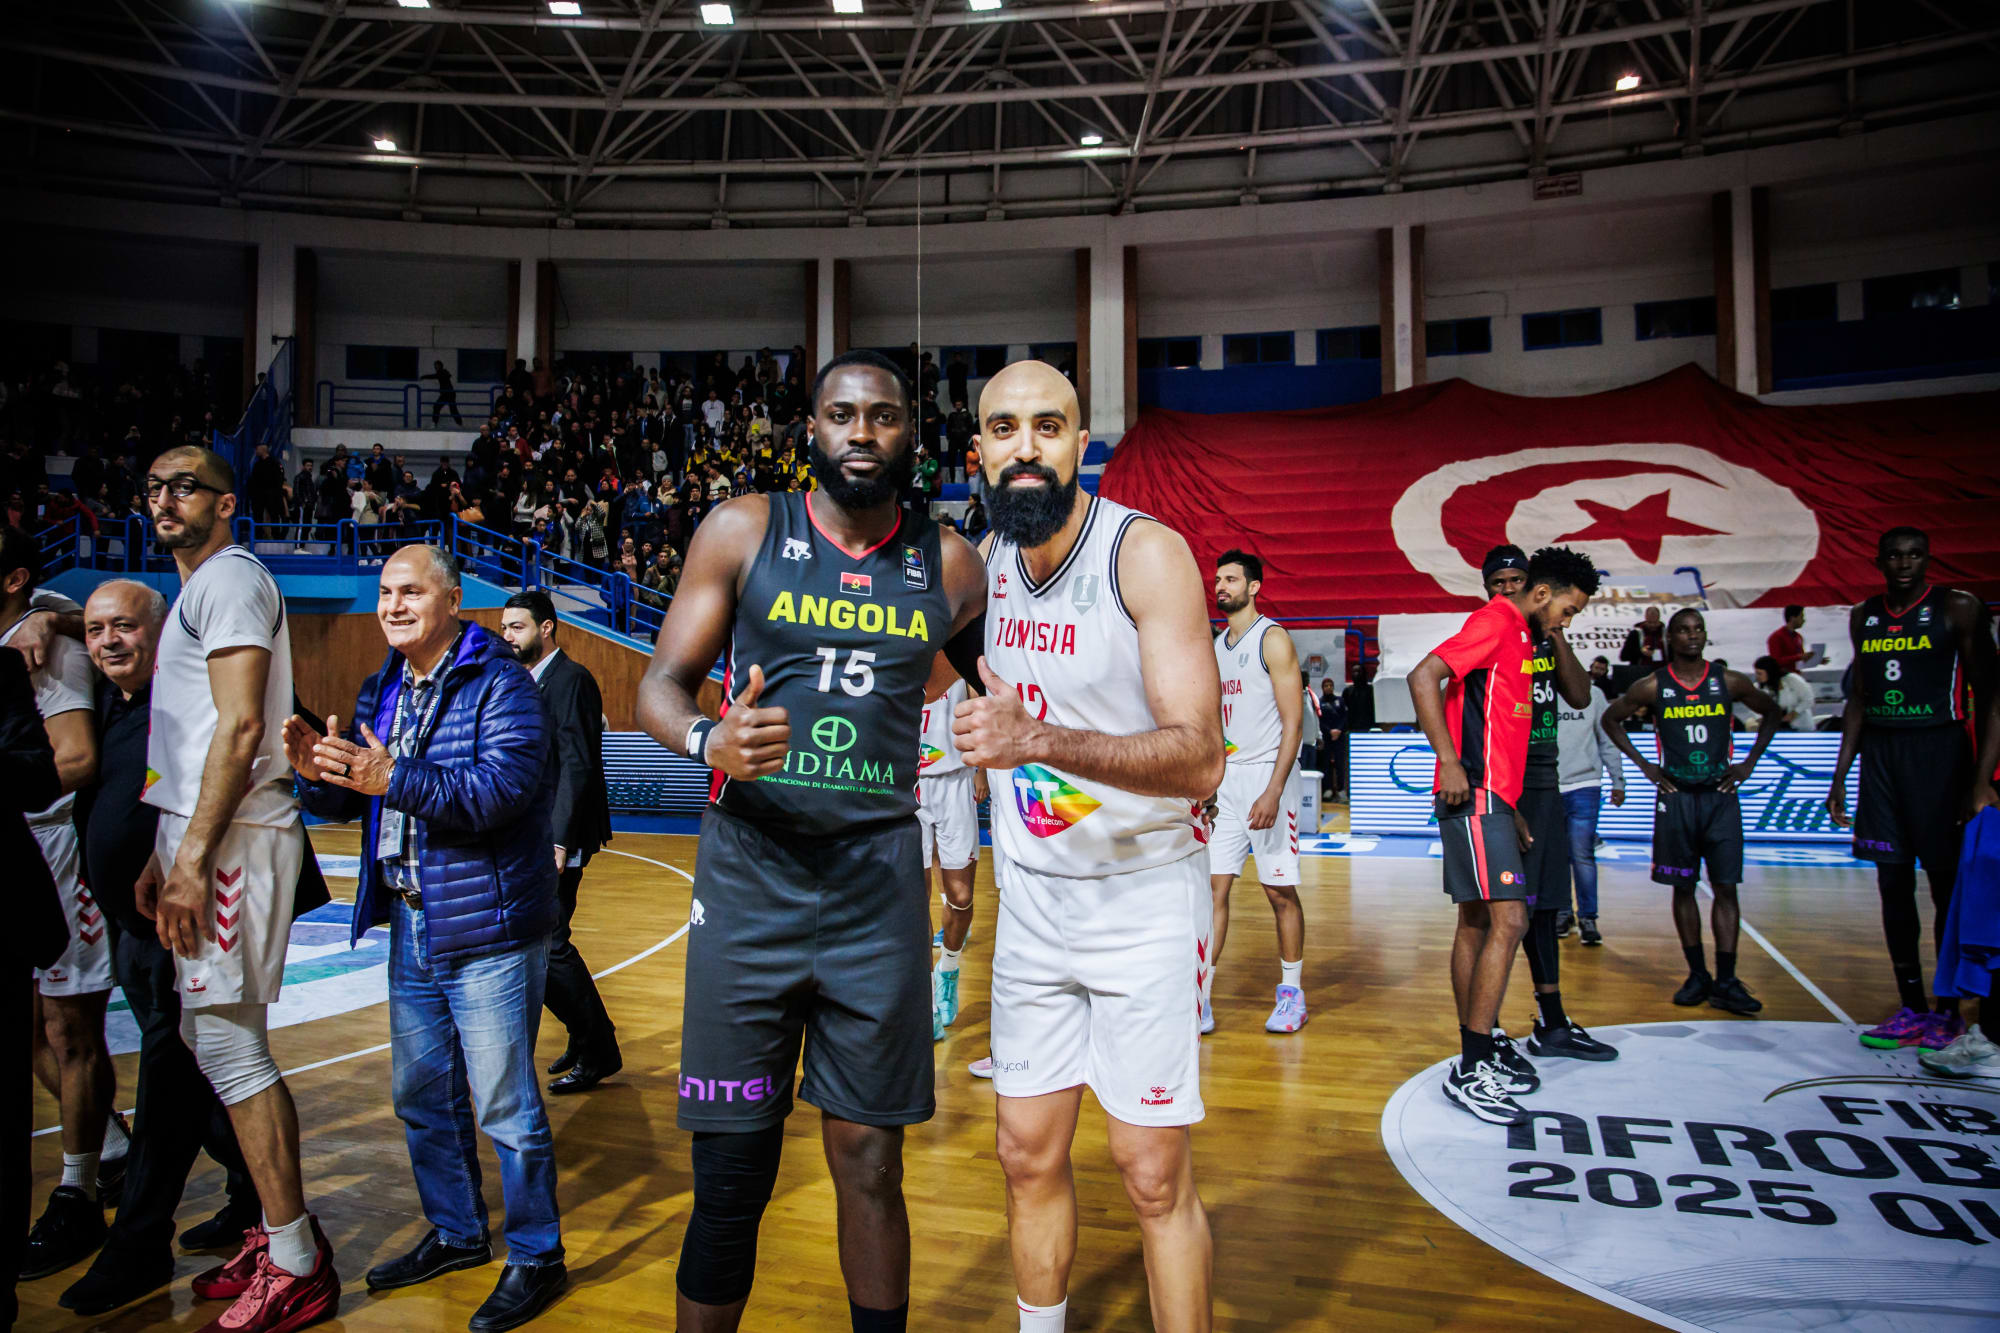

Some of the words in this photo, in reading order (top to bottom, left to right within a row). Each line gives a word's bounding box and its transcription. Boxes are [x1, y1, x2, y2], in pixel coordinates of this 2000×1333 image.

[768, 591, 929, 642] ANGOLA
[996, 617, 1076, 656] TUNISIA
[1861, 635, 1932, 654] ANGOLA
[816, 647, 876, 697] 15
[1884, 659, 1902, 681] 8
[1533, 680, 1554, 704] 56
[1663, 703, 1725, 719] ANGOLA
[1685, 725, 1708, 744] 10
[1014, 777, 1060, 817] TT
[1140, 1096, 1174, 1106] hummel
[1507, 1161, 1838, 1225] 2025
